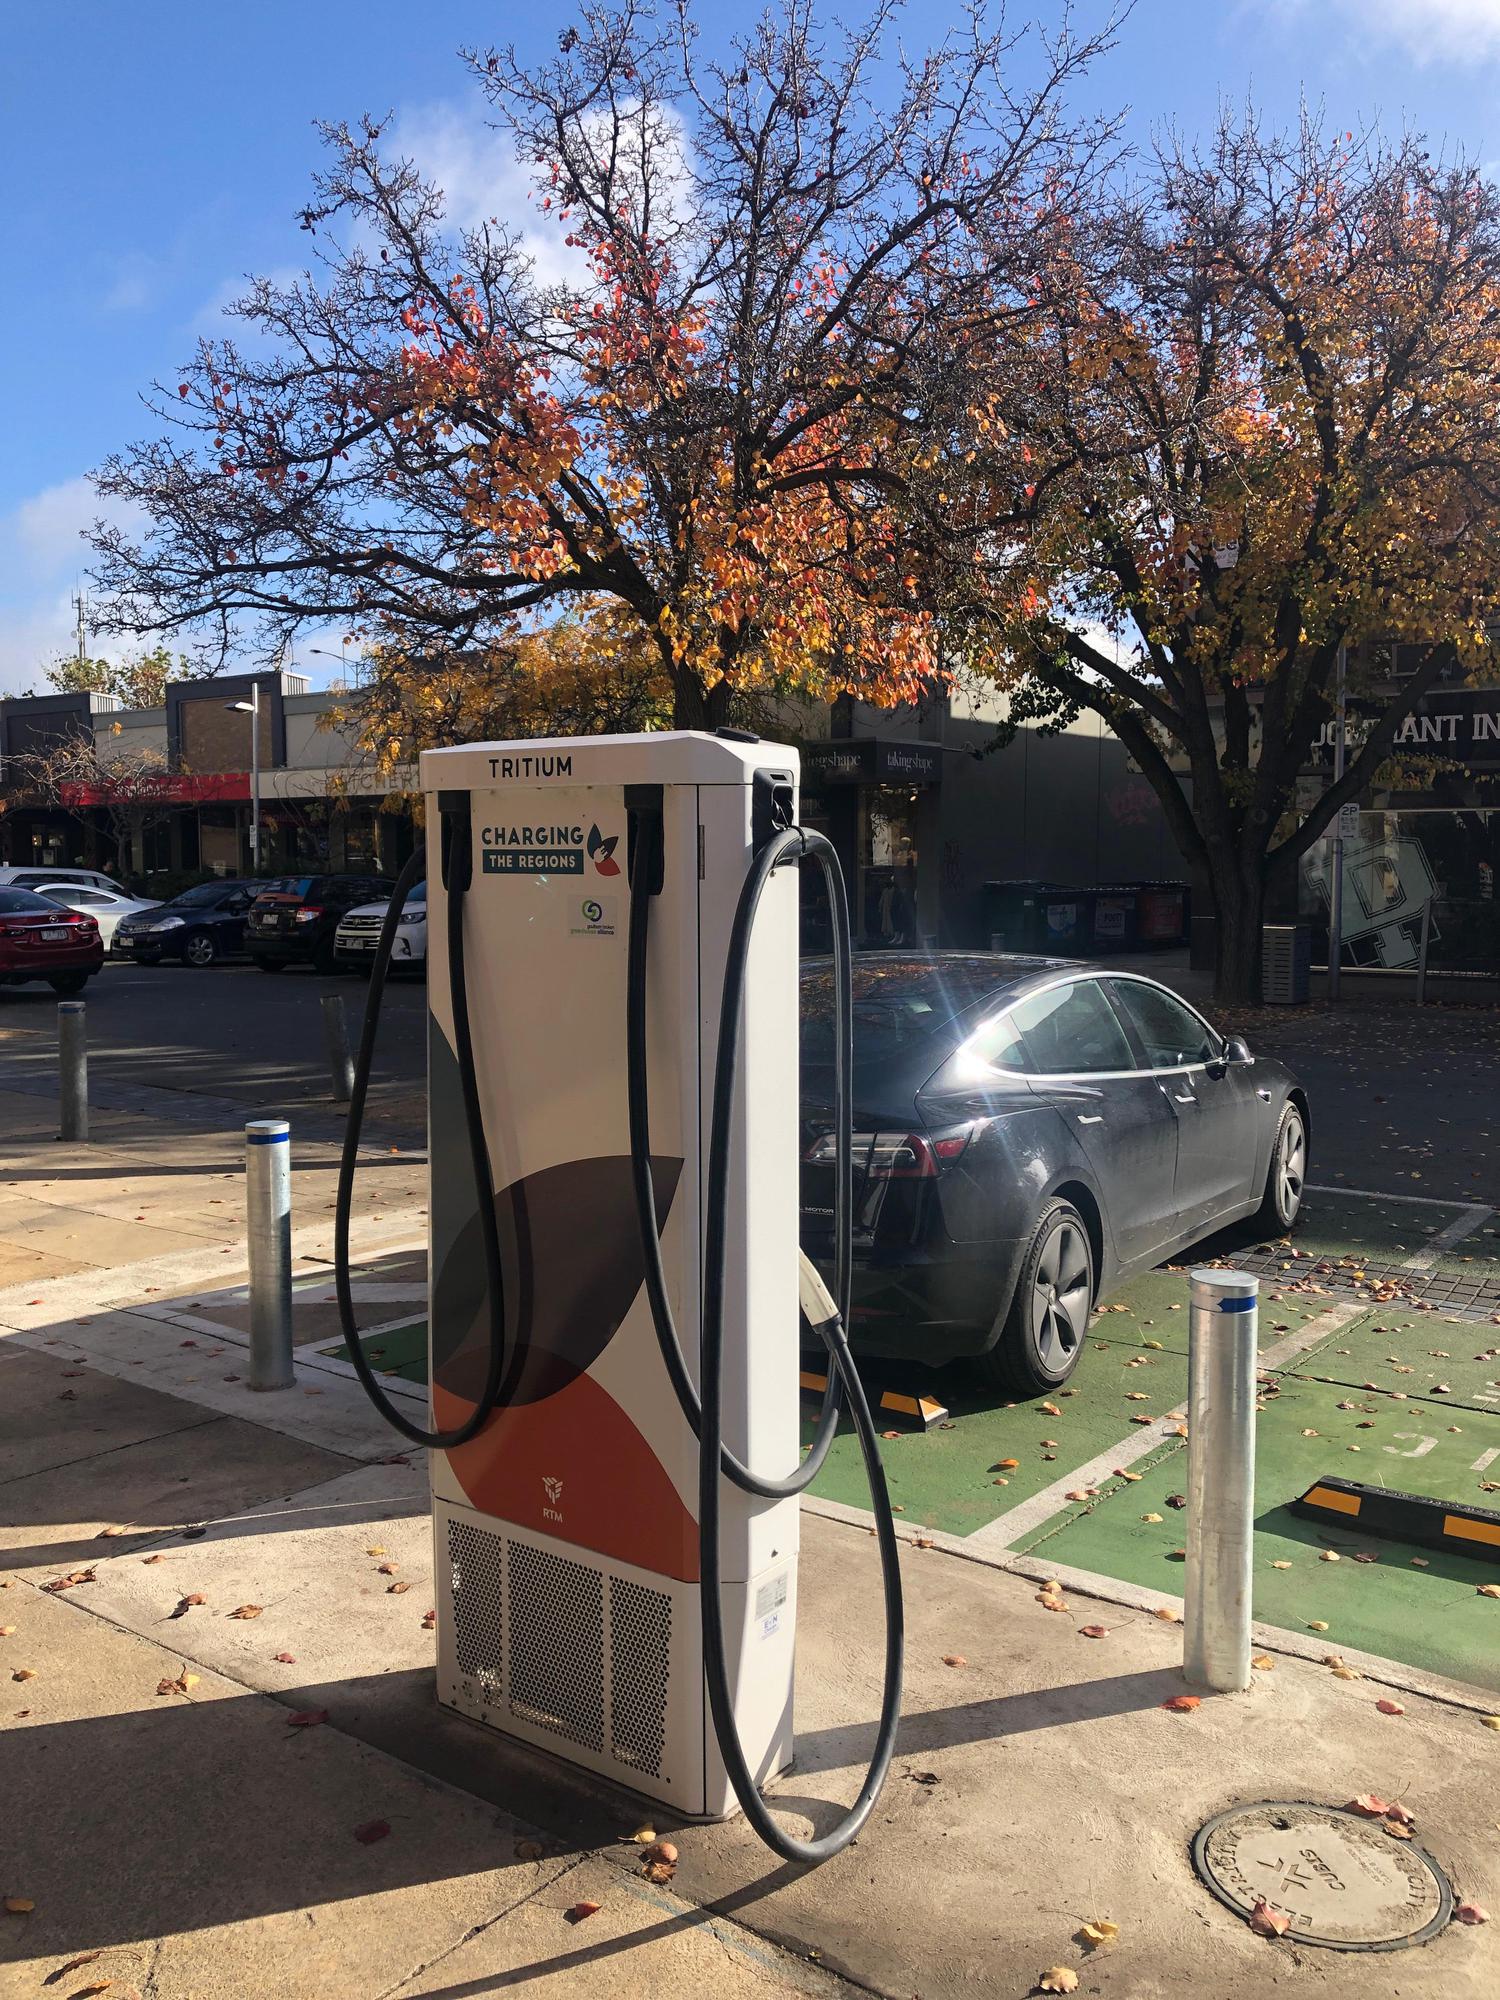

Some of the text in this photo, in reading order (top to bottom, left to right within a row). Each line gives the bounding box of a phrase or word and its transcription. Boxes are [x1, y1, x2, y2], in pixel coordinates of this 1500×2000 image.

[489, 756, 573, 778] TRITIUM
[1341, 806, 1358, 816] 2P
[482, 826, 584, 845] CHARGING
[490, 855, 576, 868] THE REGIONS
[543, 1507, 563, 1523] RTM
[1299, 1849, 1346, 1891] CUBIS
